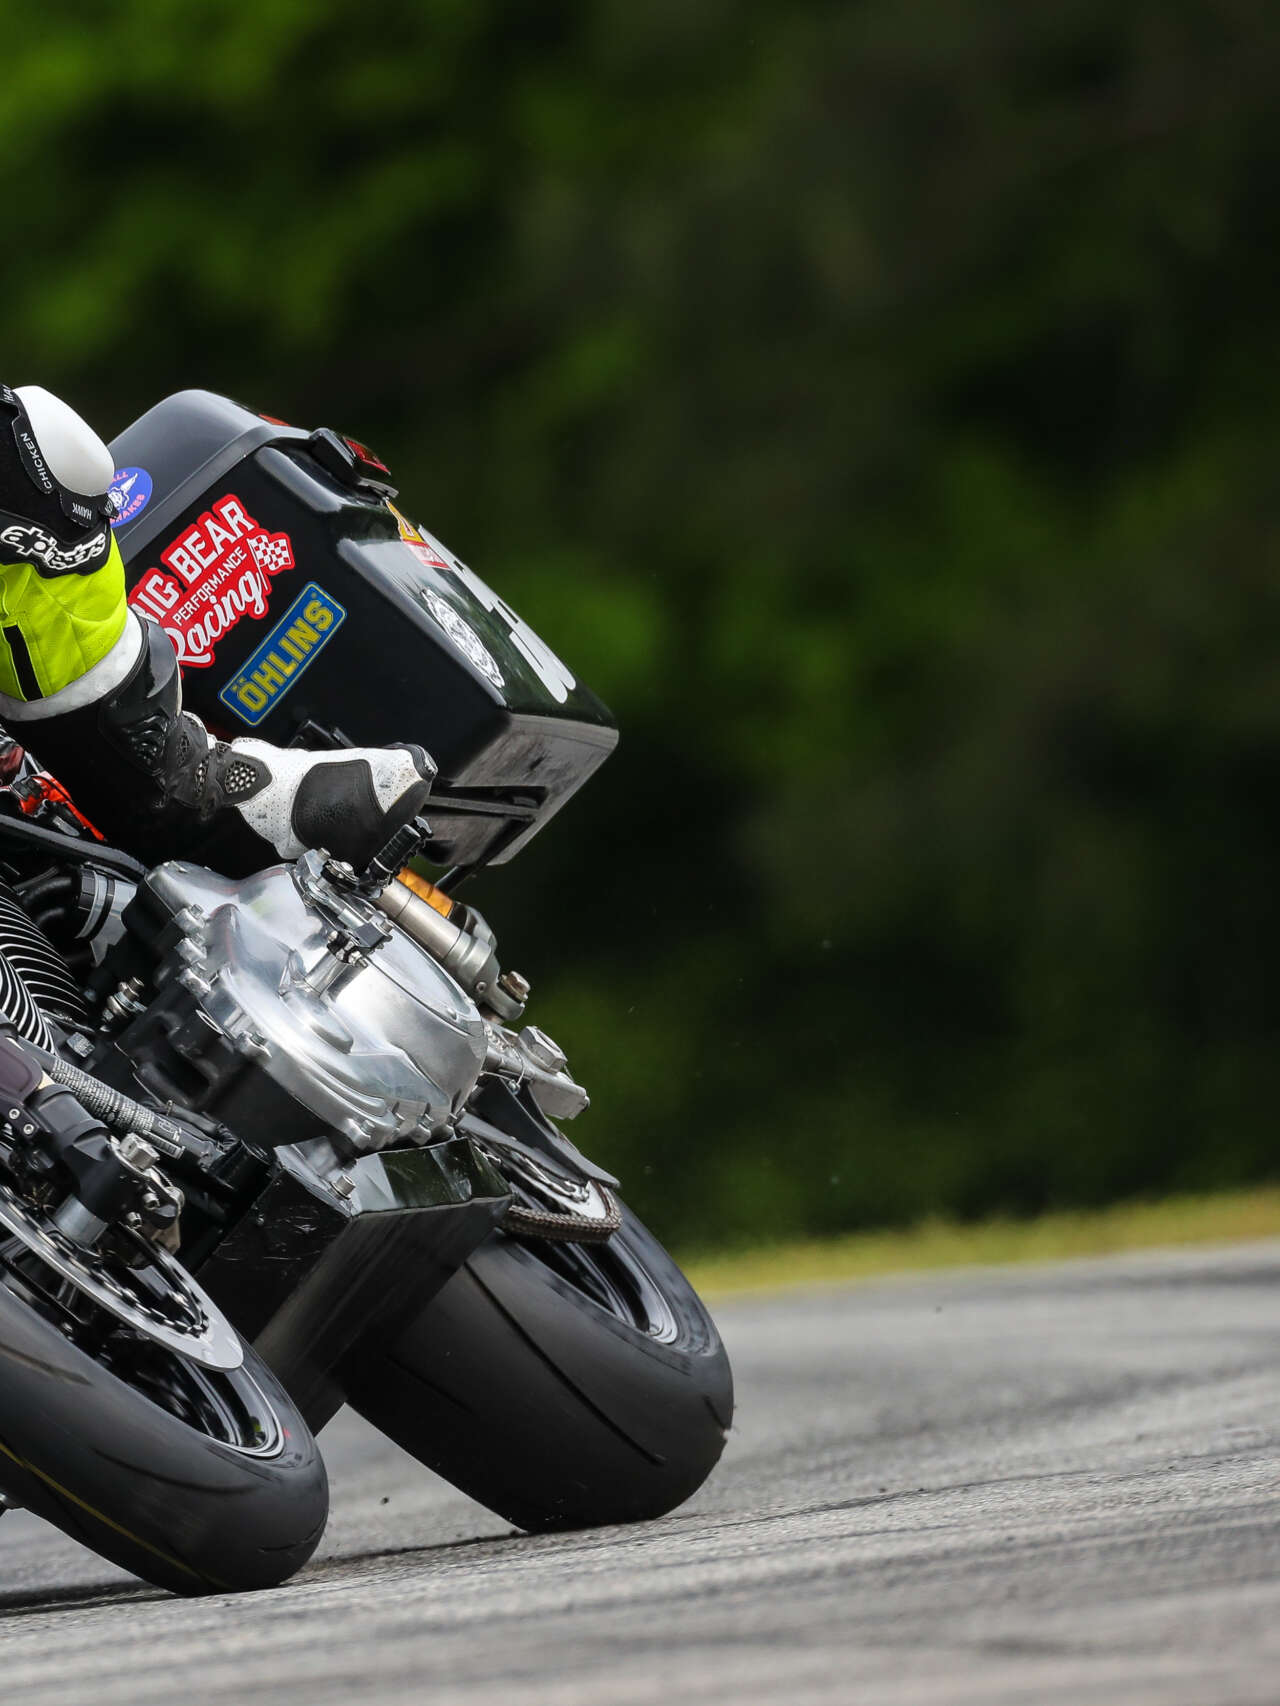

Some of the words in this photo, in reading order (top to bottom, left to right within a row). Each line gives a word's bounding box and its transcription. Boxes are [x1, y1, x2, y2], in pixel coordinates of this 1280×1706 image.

[20, 432, 52, 490] CHICKEN
[72, 502, 92, 520] HAWK
[168, 500, 255, 584] BEAR
[172, 546, 247, 626] PERFORMANCE
[232, 600, 334, 712] ÖHLINS
